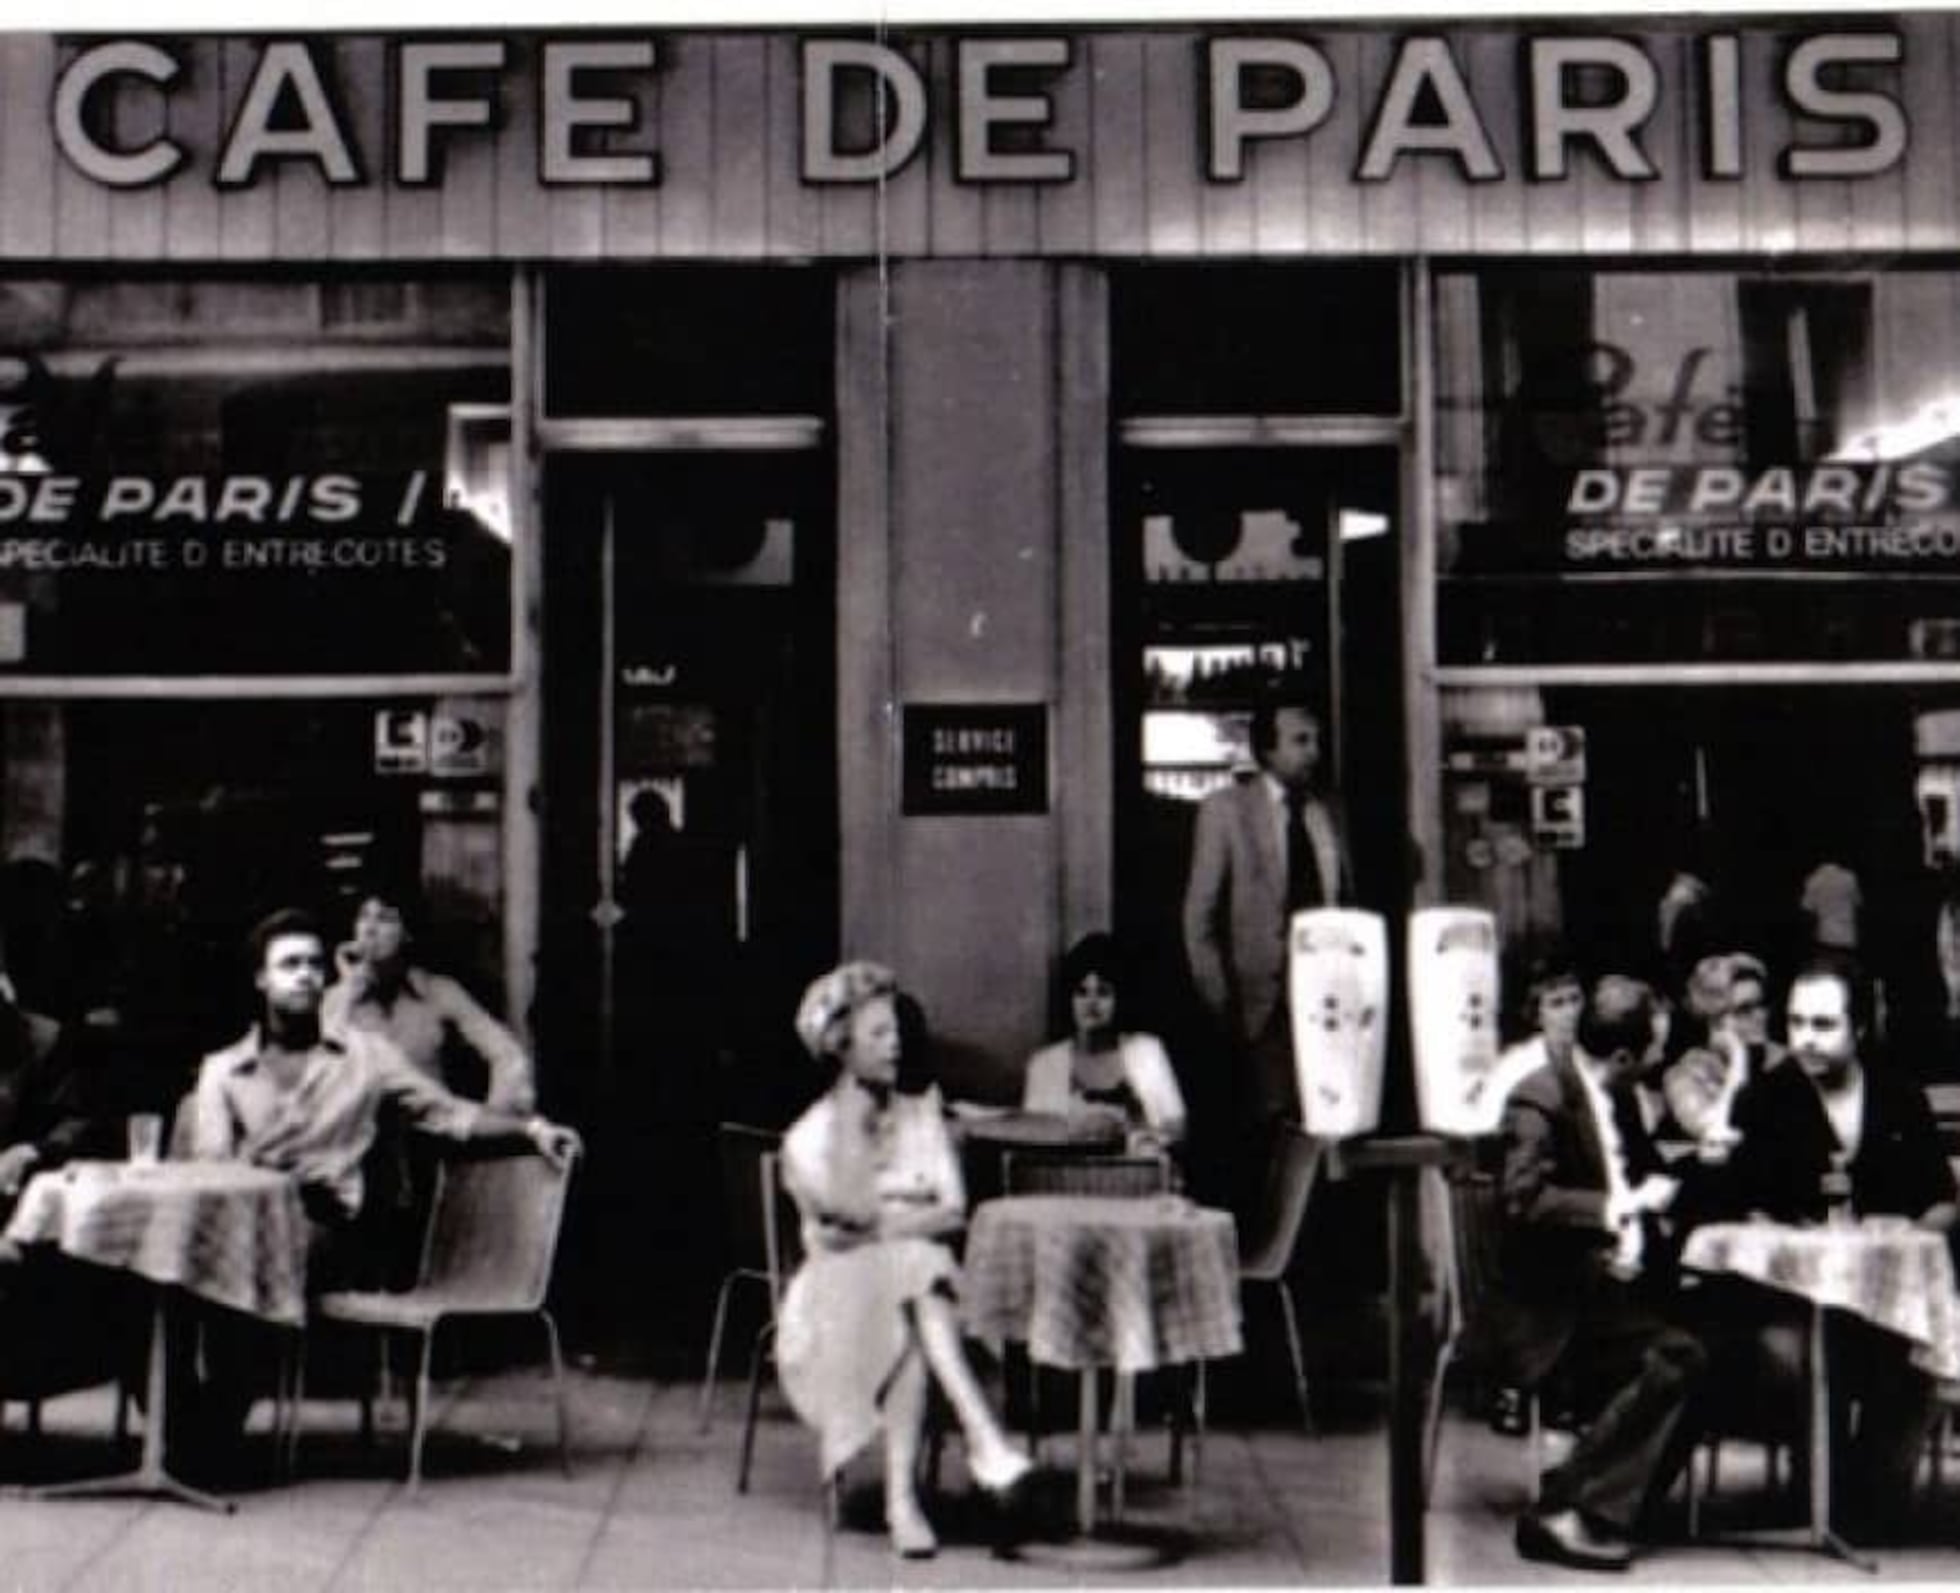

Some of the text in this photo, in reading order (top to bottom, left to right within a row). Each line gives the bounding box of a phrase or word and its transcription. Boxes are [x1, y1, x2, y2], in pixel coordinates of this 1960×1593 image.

[54, 33, 1907, 185] CAFE DE PARIS
[101, 475, 362, 522] PARIS
[1566, 464, 1950, 514] DE PARIS
[0, 539, 168, 568] PECIALITE
